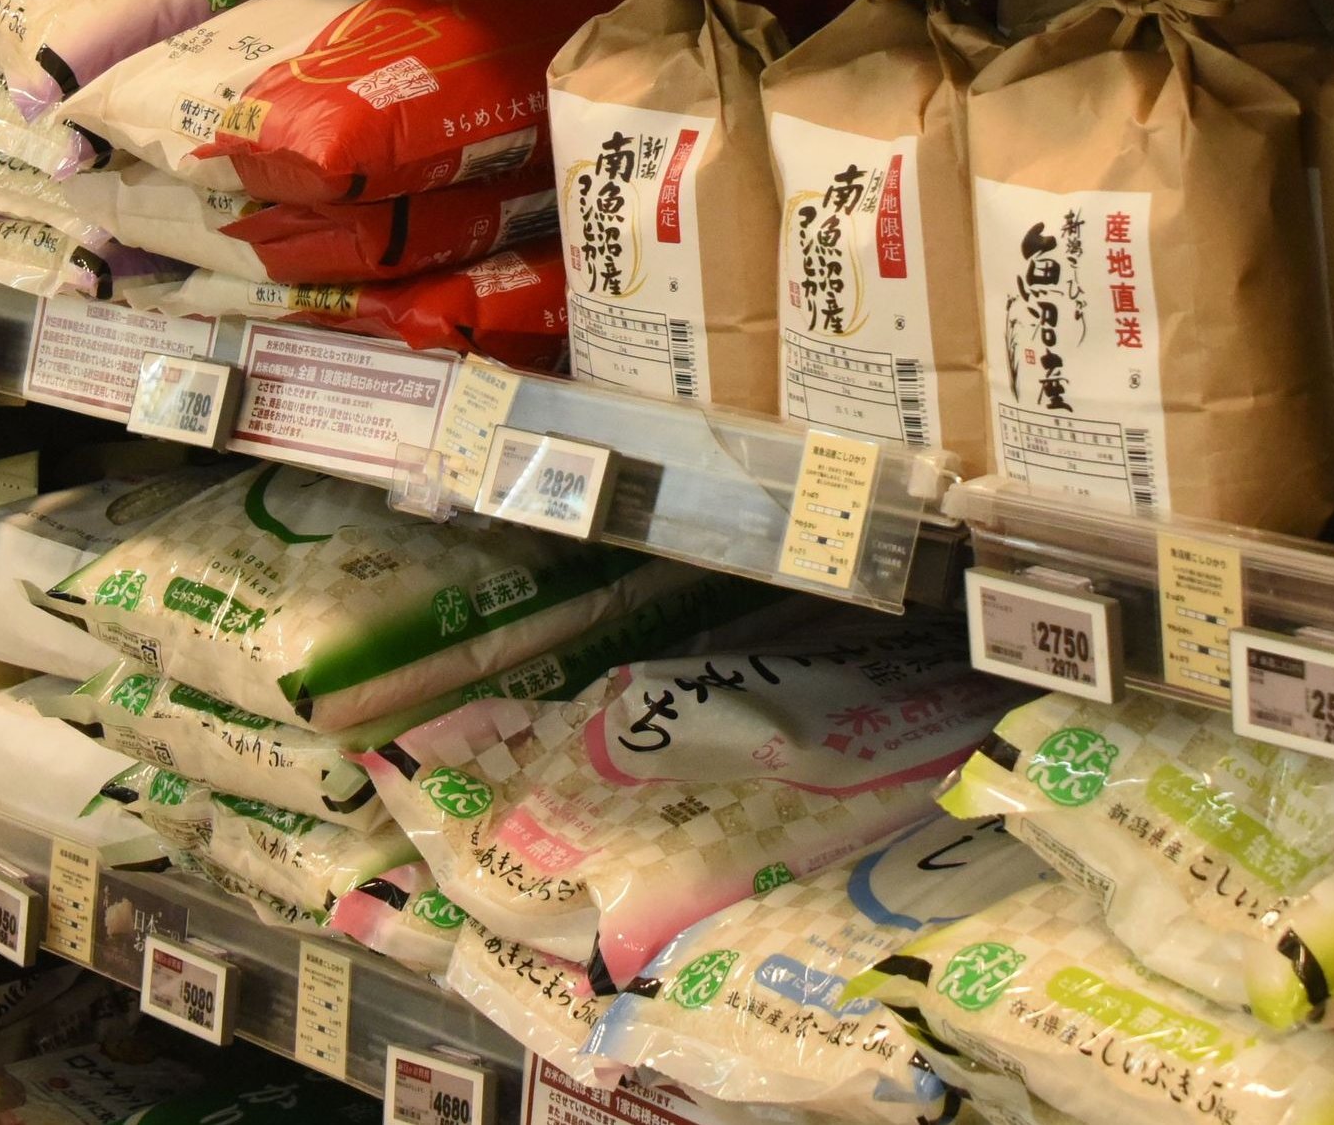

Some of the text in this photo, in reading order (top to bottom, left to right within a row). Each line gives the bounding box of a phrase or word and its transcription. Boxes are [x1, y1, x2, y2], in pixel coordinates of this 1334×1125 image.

[227, 34, 275, 62] 5kg
[441, 91, 549, 139] きらめく大粒
[657, 140, 695, 230] 産地限定
[578, 174, 599, 294] コシヒカリ
[594, 131, 635, 297] 南魚沼産
[878, 168, 907, 263] 産地限定
[797, 205, 818, 332] コシヒカリ
[816, 165, 867, 335] 南魚沼産
[294, 282, 356, 312] 無洗米
[1104, 210, 1144, 349] 産地直送
[1016, 220, 1074, 413] 魚沼産
[539, 466, 586, 497] 2820
[473, 578, 535, 613] 無洗米
[1037, 621, 1089, 663] 2750
[506, 664, 562, 699] 無洗米
[1106, 801, 1186, 865] 新潟県産
[182, 983, 214, 1012] 5080
[862, 1023, 900, 1062] 5kg
[433, 1091, 470, 1122] 4680
